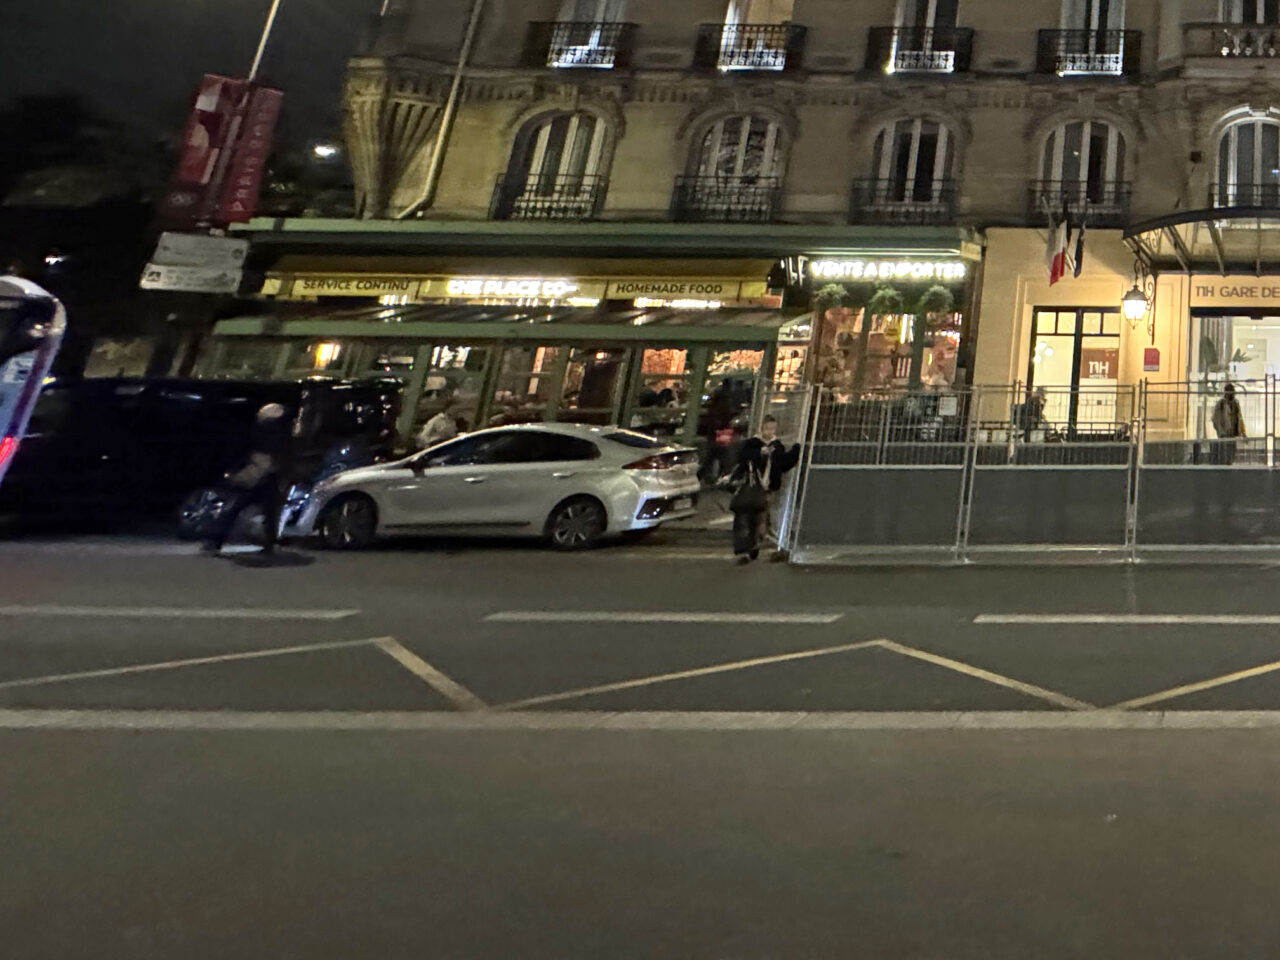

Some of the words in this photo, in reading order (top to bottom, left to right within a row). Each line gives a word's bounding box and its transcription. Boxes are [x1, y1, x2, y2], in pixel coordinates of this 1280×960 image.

[811, 261, 864, 277] VENTE
[879, 261, 965, 278] EMPORTER
[303, 280, 351, 290] SERVICE
[356, 280, 409, 290] CONTINU
[484, 281, 541, 296] PLACE
[616, 283, 686, 294] HOMEMADE
[688, 284, 723, 294] FOOD
[1219, 286, 1259, 298] GARE
[1261, 287, 1280, 298] DE
